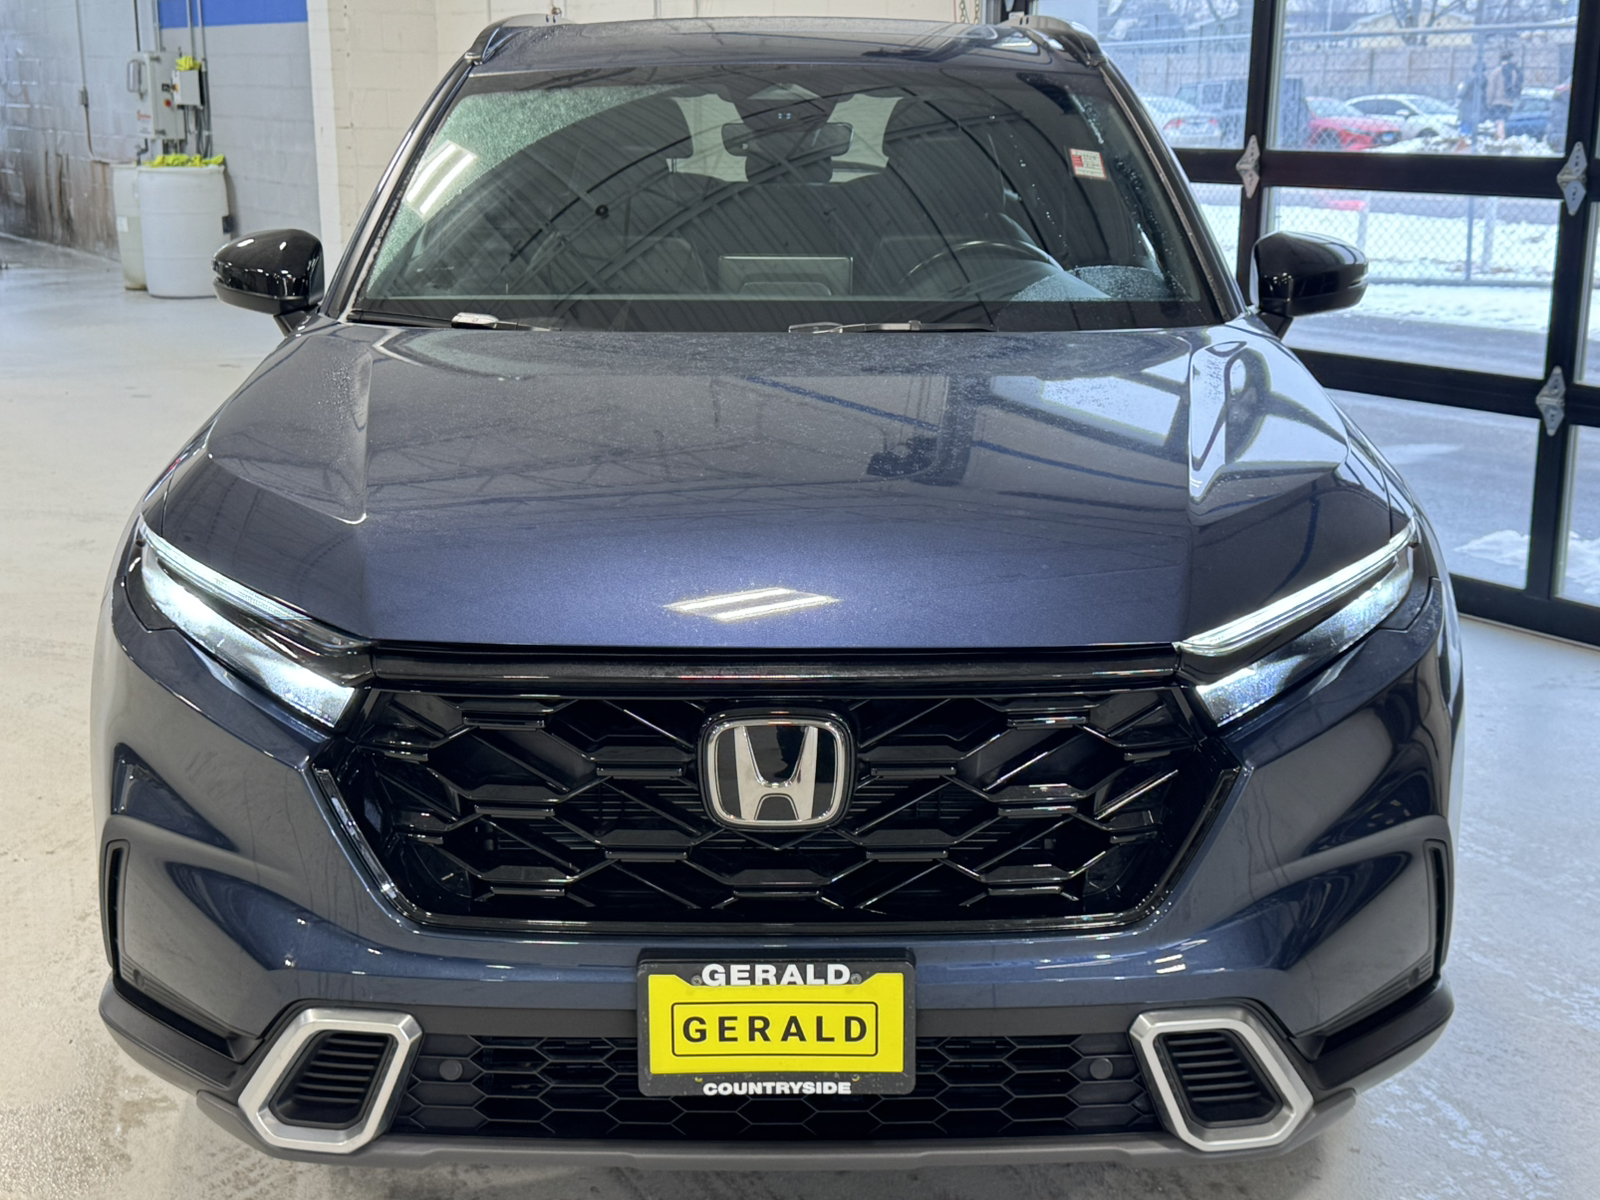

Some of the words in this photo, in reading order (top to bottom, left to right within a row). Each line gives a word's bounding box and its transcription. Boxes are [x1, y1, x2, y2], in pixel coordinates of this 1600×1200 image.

[702, 963, 851, 986] GERALD
[683, 1015, 867, 1043] GERALD
[703, 1081, 852, 1096] COUNTRYSIDE
